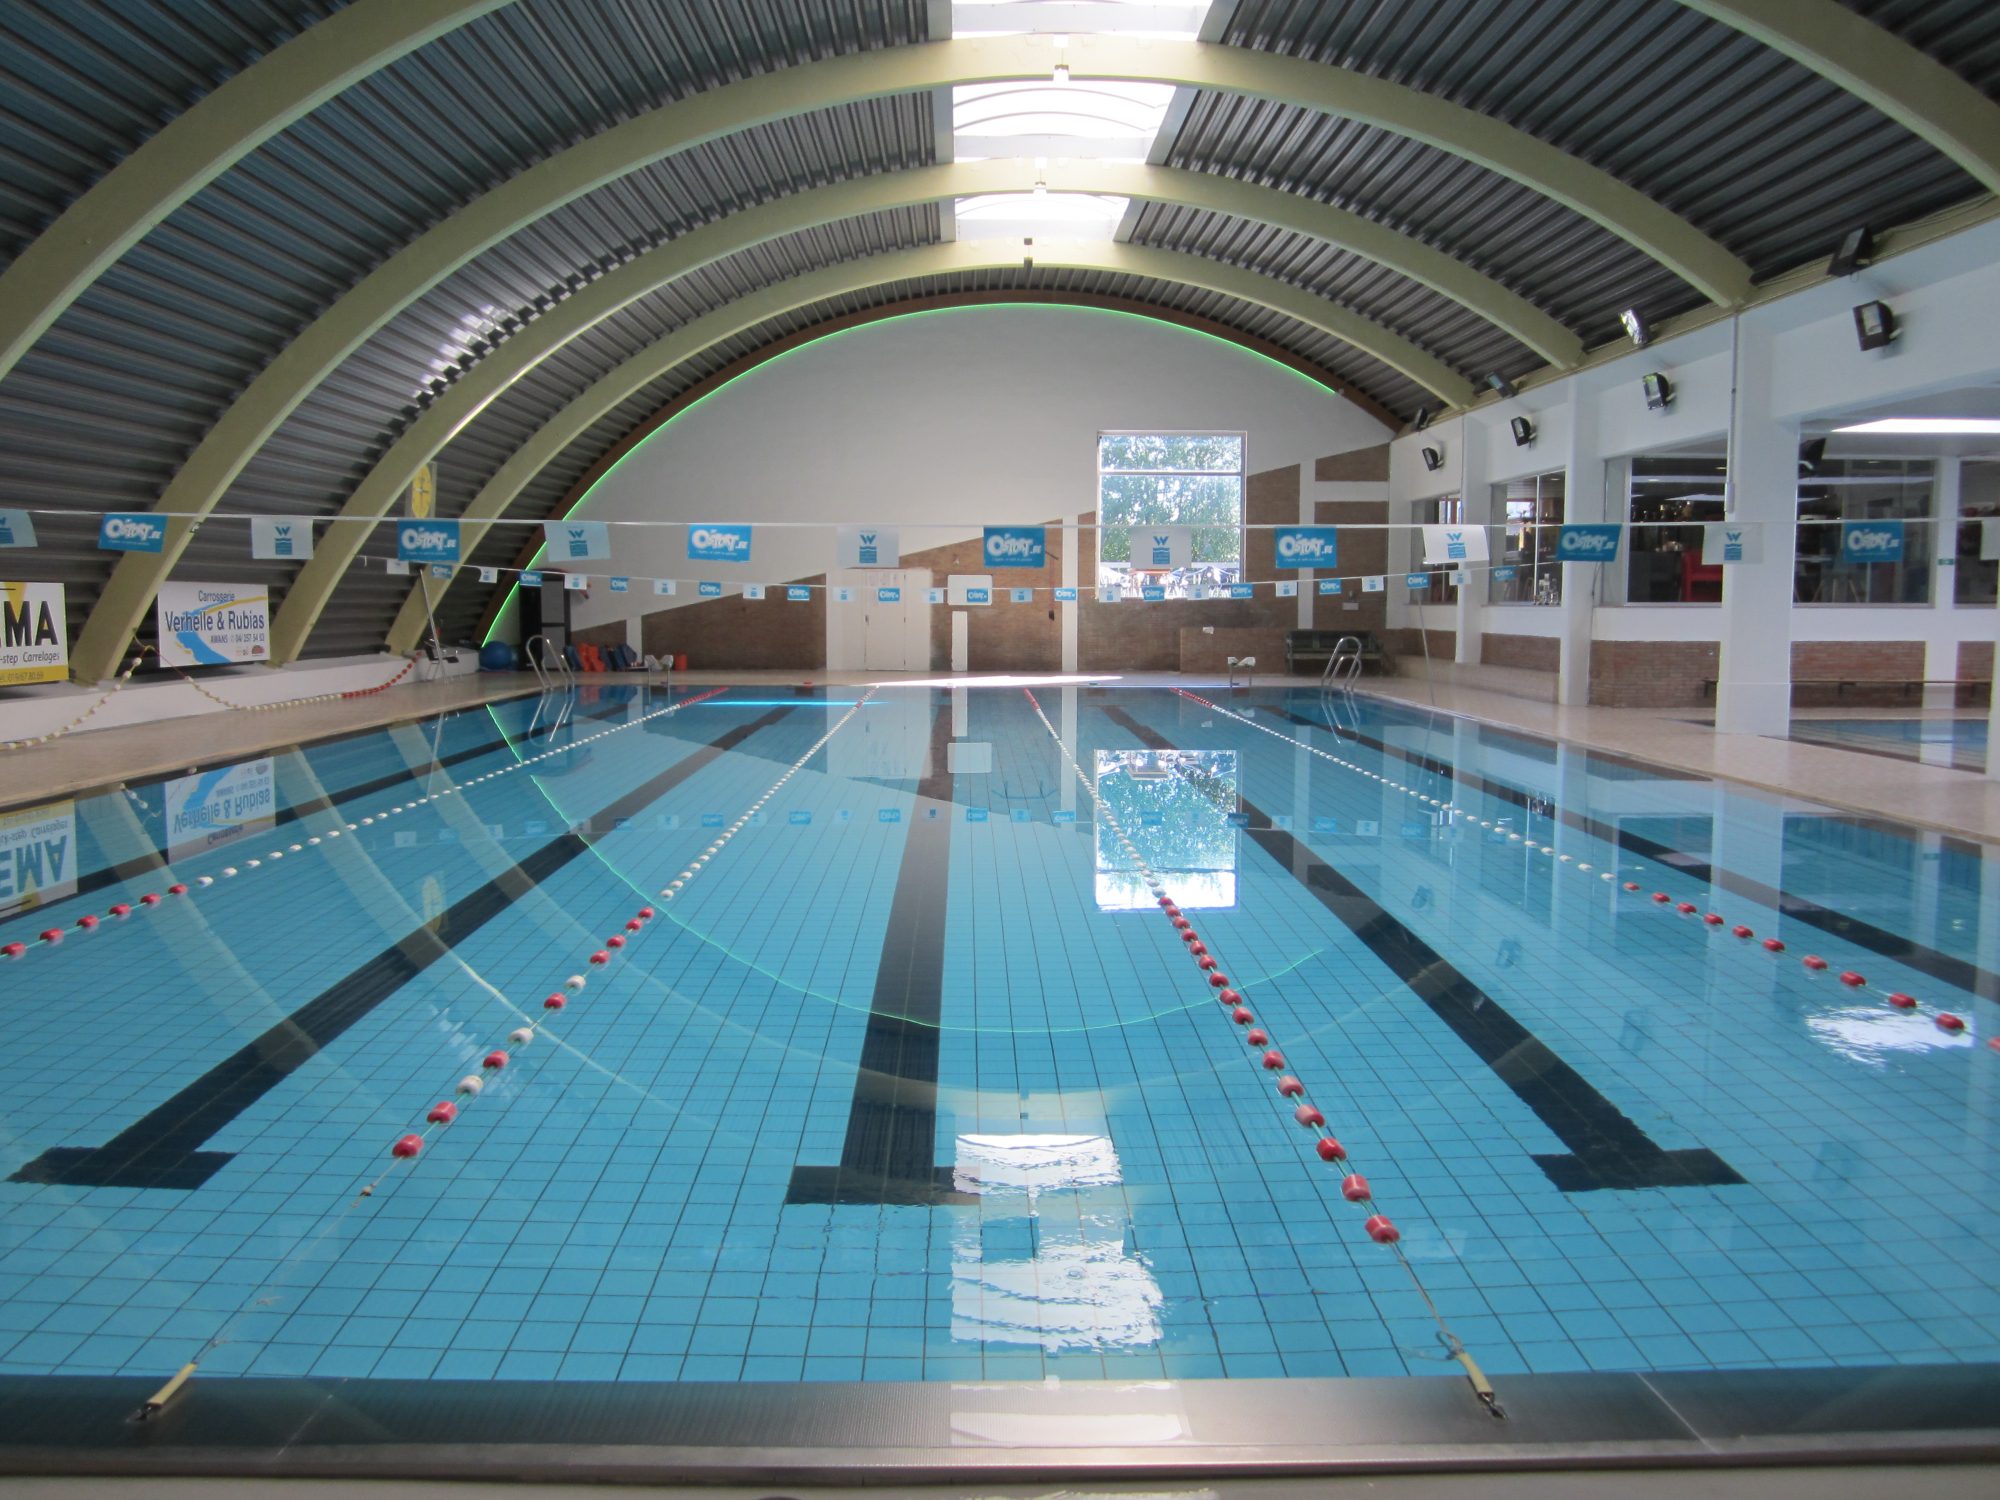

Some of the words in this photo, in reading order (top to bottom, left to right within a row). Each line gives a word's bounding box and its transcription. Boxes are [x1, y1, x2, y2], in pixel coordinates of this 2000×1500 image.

[275, 526, 291, 536] W
[568, 529, 584, 538] W
[859, 534, 876, 544] W
[1152, 536, 1169, 545] W
[1446, 532, 1462, 541] W
[1726, 532, 1742, 542] W
[199, 590, 235, 602] Carrosserie
[0, 600, 58, 647] MA
[165, 611, 213, 632] Verhelle
[217, 611, 225, 630] &
[228, 610, 265, 630] Rubias
[23, 650, 60, 663] Carrelages
